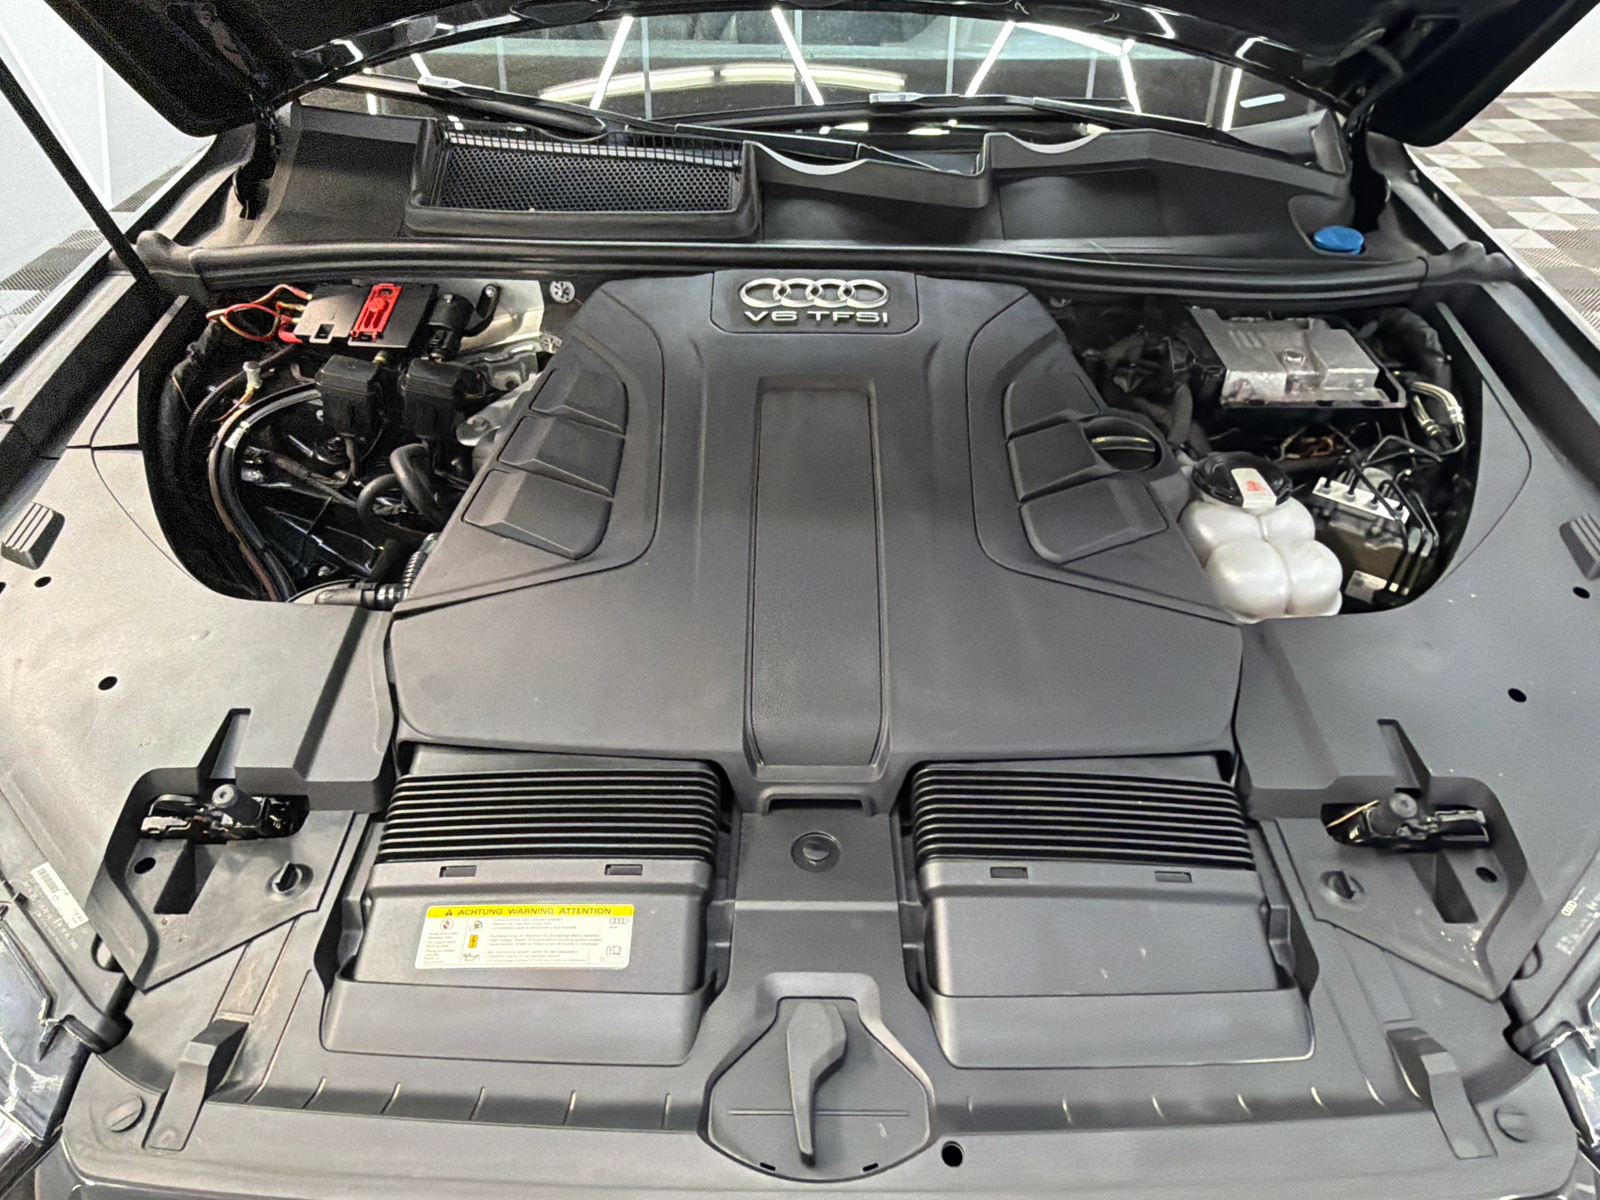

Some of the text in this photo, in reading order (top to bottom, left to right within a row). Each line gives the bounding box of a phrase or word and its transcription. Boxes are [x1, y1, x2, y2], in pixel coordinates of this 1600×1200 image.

[744, 310, 888, 324] V6 TFSI
[457, 907, 612, 916] ACHTUNG WARNING ATTENTION
